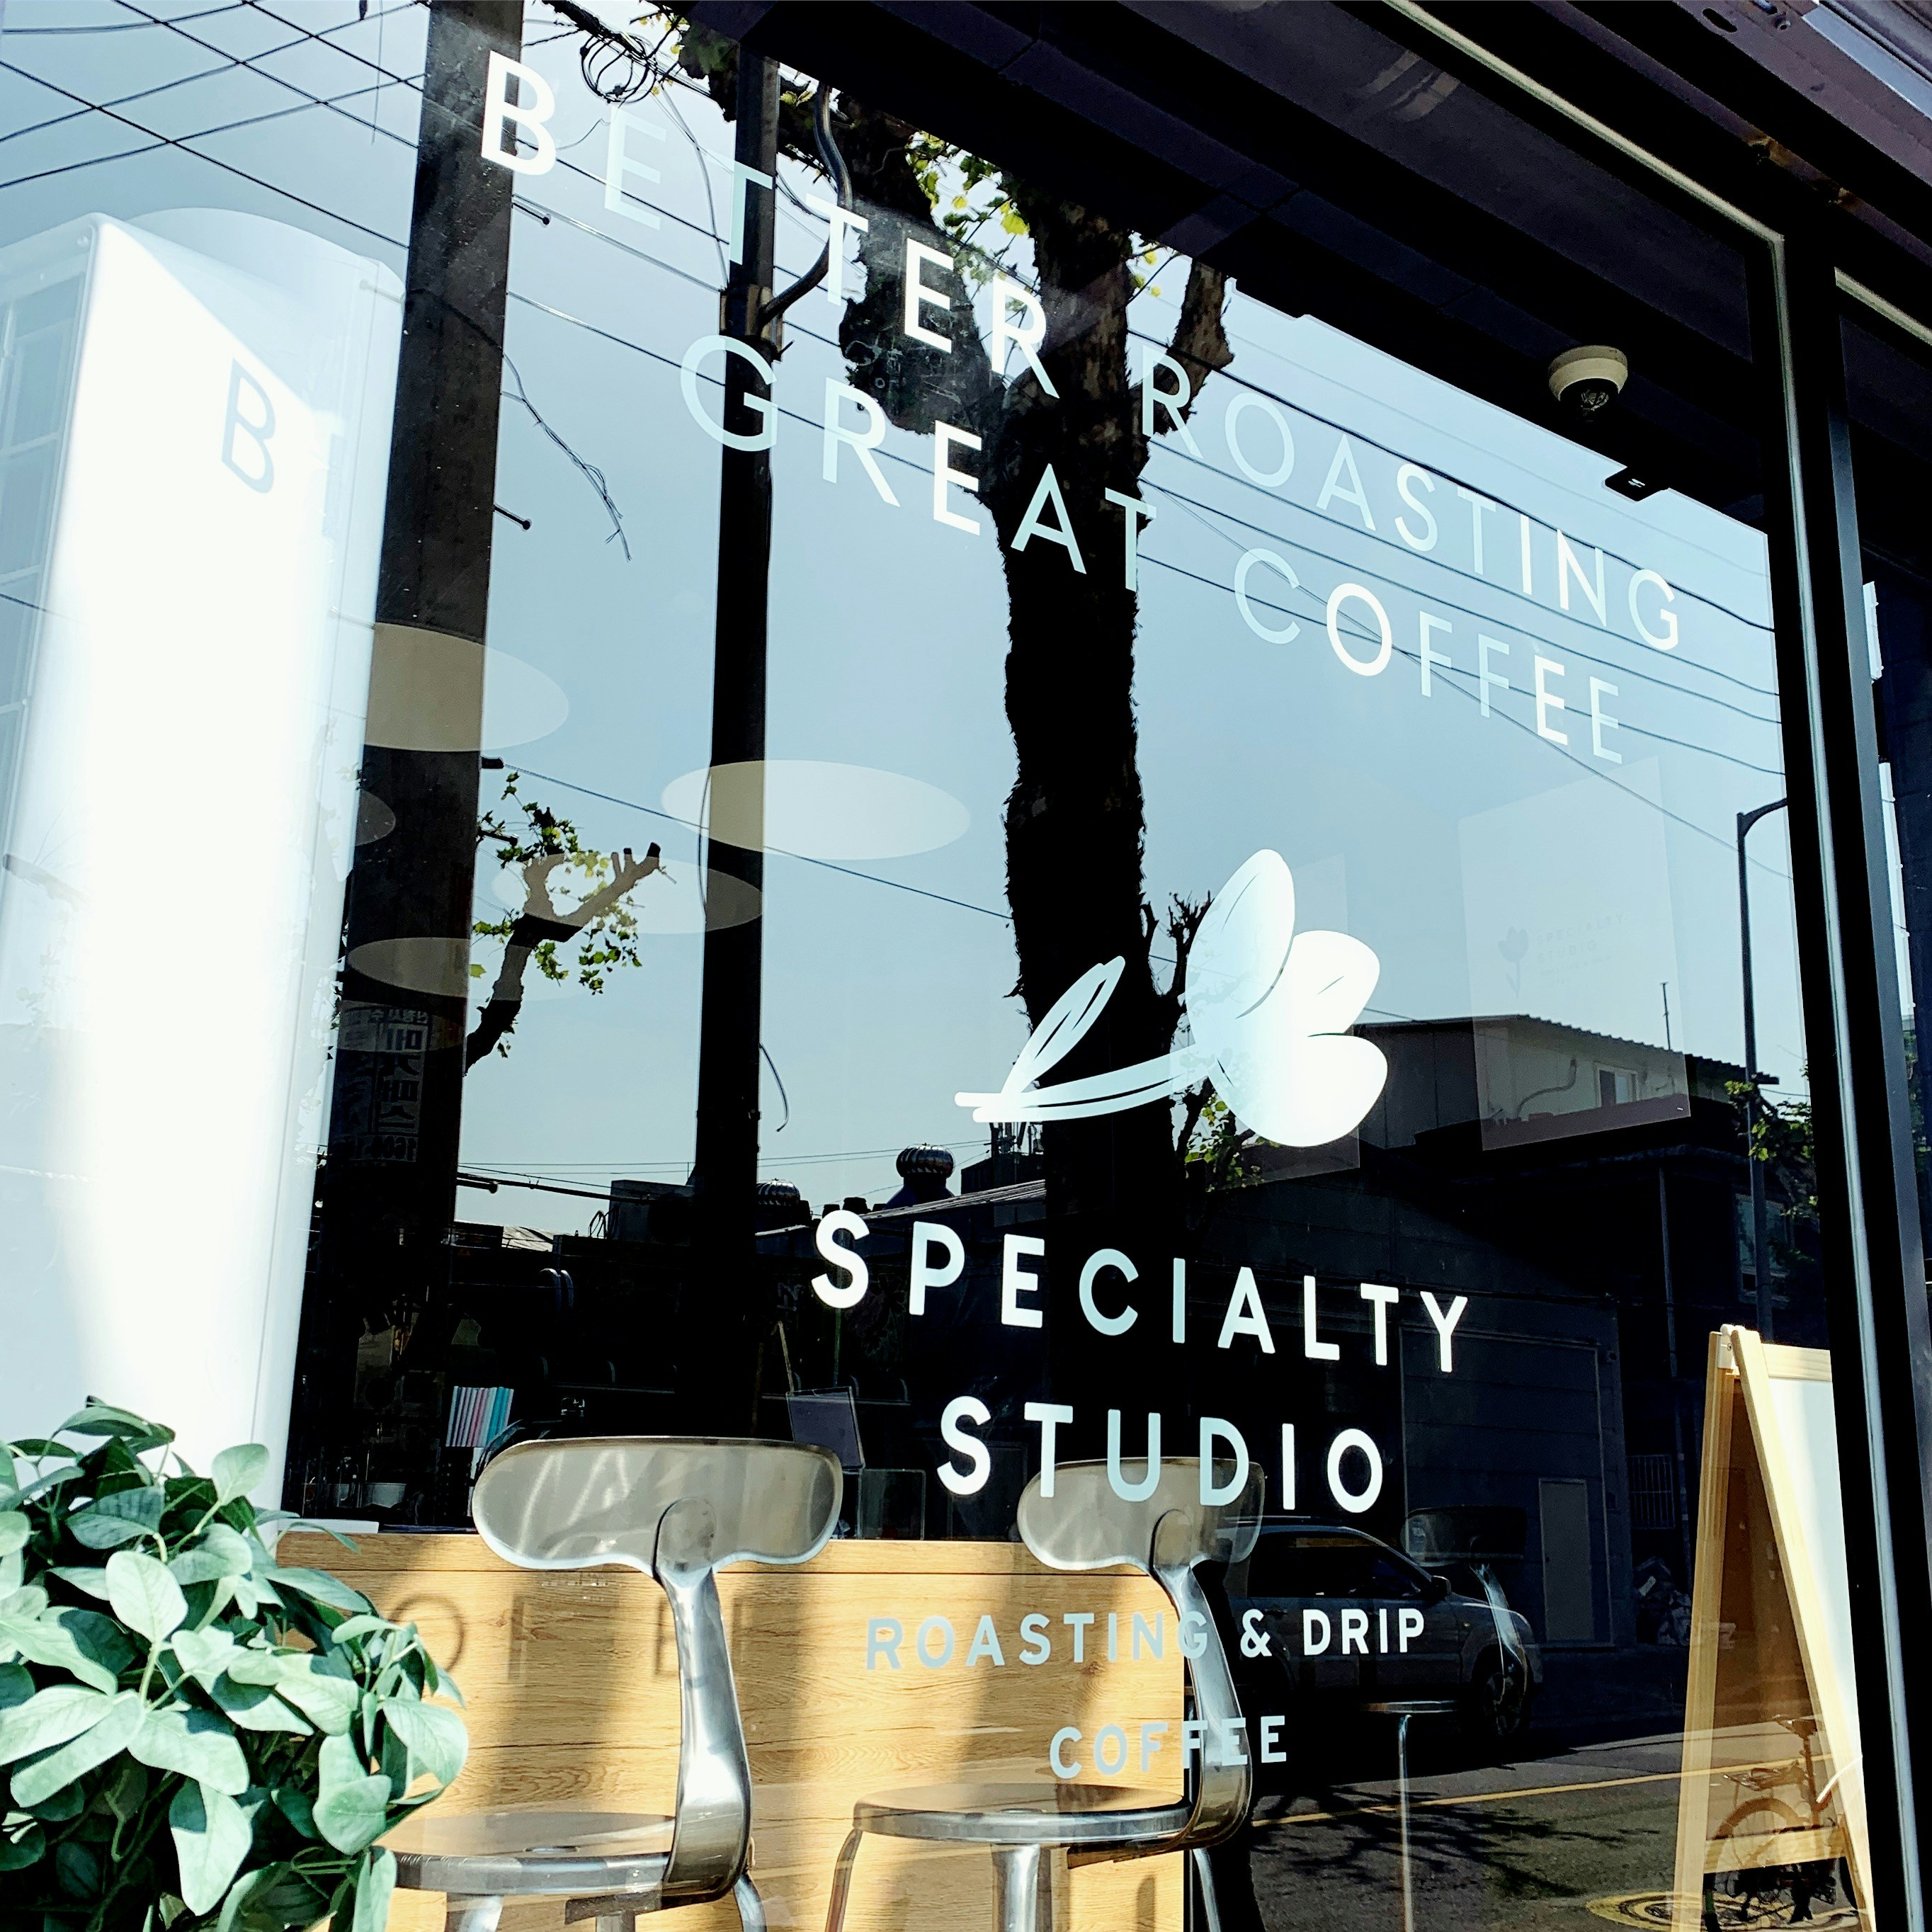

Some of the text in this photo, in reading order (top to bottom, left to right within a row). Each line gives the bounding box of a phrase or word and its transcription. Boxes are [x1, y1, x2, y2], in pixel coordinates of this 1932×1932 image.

[481, 50, 1678, 650] BETTER ROASTING
[221, 357, 276, 494] B
[680, 334, 1623, 764] GREAT COFFEE
[1537, 912, 1623, 945] SPECIALTY
[1538, 940, 1597, 964] STUDIO
[811, 1210, 1467, 1373] SPECIALTY
[937, 1396, 1382, 1513] STUDIO
[866, 1608, 1424, 1670] ROASTING & DRIP
[1050, 1715, 1287, 1779] COFFEE
